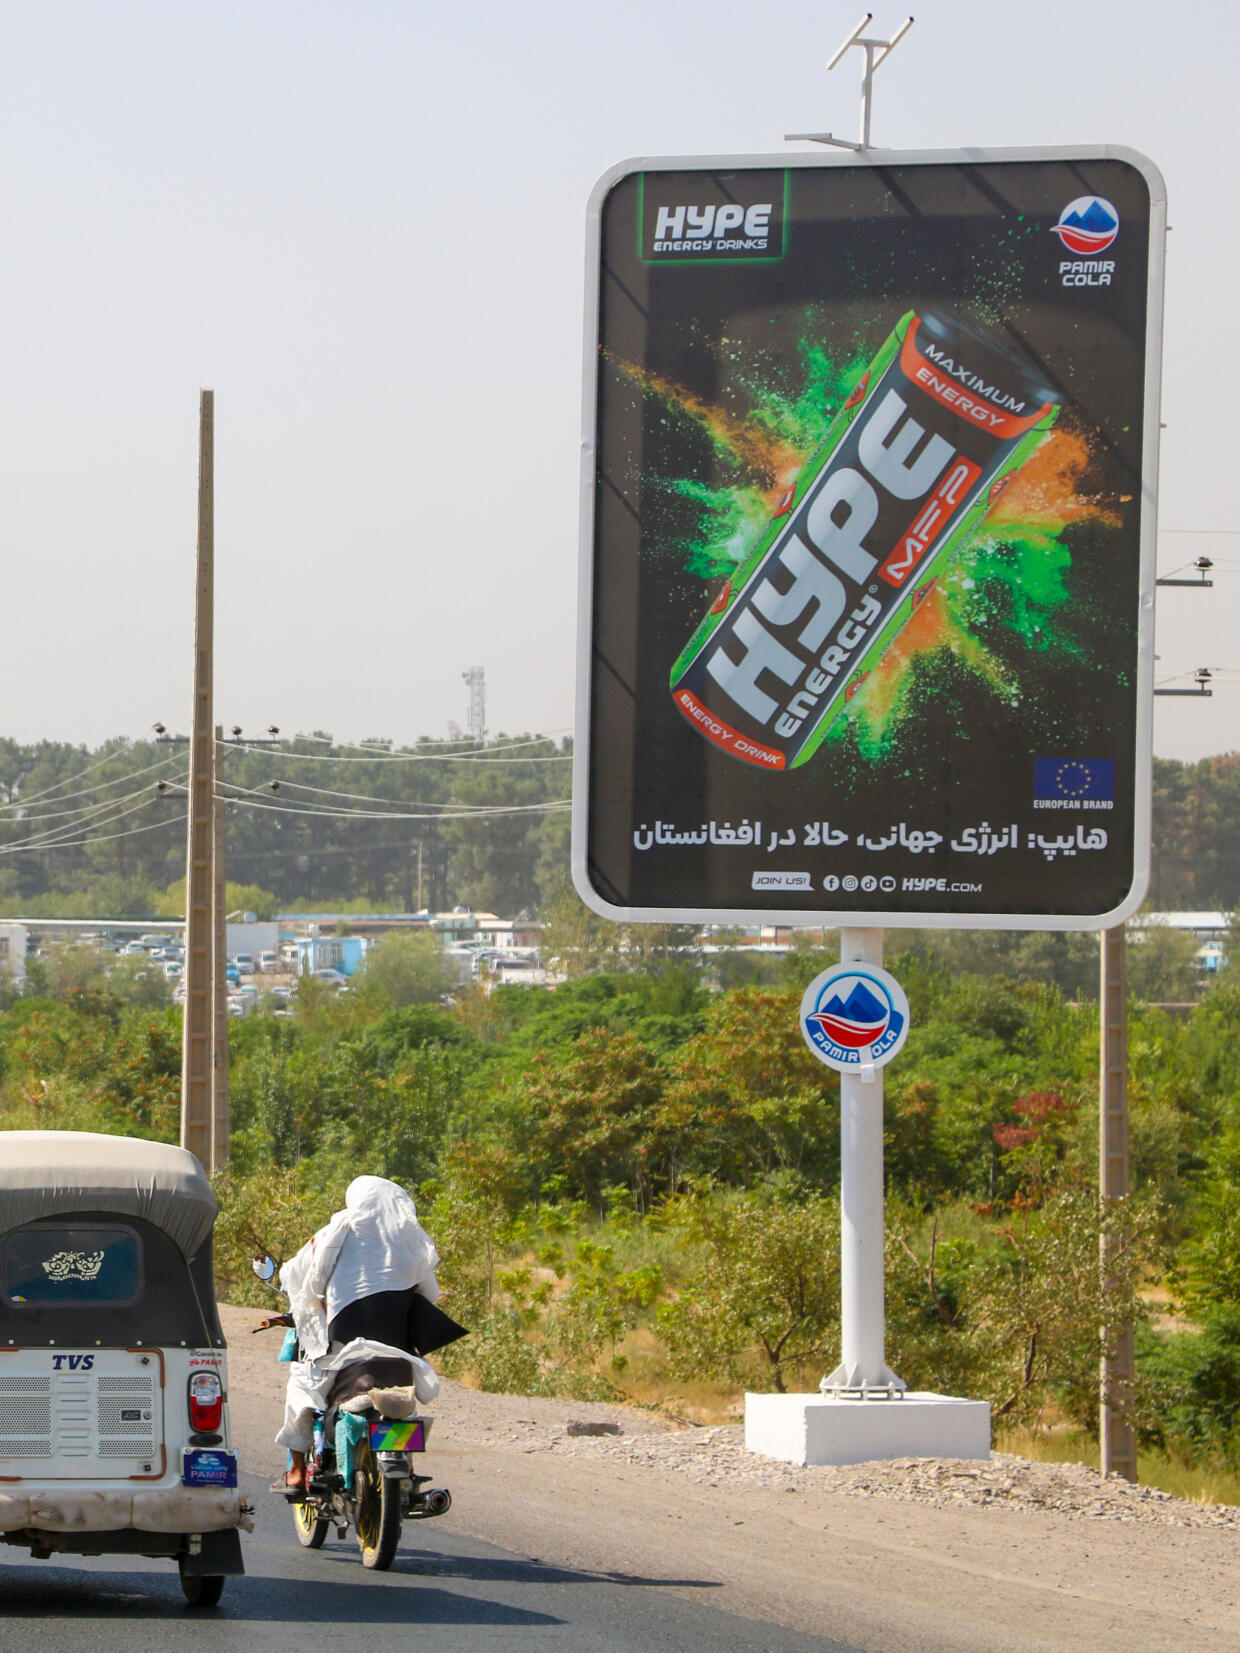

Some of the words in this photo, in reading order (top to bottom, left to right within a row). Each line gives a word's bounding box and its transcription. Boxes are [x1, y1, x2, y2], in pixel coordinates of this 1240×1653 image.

[655, 204, 772, 239] HYPE
[653, 240, 712, 252] ENERGY
[716, 239, 767, 250] DRINKS
[1059, 261, 1115, 274] PAMIR
[1062, 274, 1112, 286] COLA
[924, 344, 1026, 413] MAXIMUM
[915, 367, 1006, 427] ENERGY
[706, 388, 957, 725] HYPE
[774, 597, 882, 738] ENERGY
[679, 694, 733, 740] ENERGY
[733, 740, 782, 764] DRINK
[1033, 800, 1080, 809] EUROPEAN
[1083, 800, 1114, 810] BRAND
[633, 819, 761, 850] افغانستان
[767, 828, 796, 852] در
[803, 822, 849, 846] حالا
[951, 822, 1018, 855] انرژی
[1028, 825, 1108, 861] هایپ:
[755, 876, 782, 885] JOIN
[785, 876, 807, 885] US!
[902, 877, 982, 892] HYPE.COM
[813, 1032, 858, 1062] PAMIR
[871, 1030, 897, 1056] OLA
[52, 1355, 94, 1370] TVS
